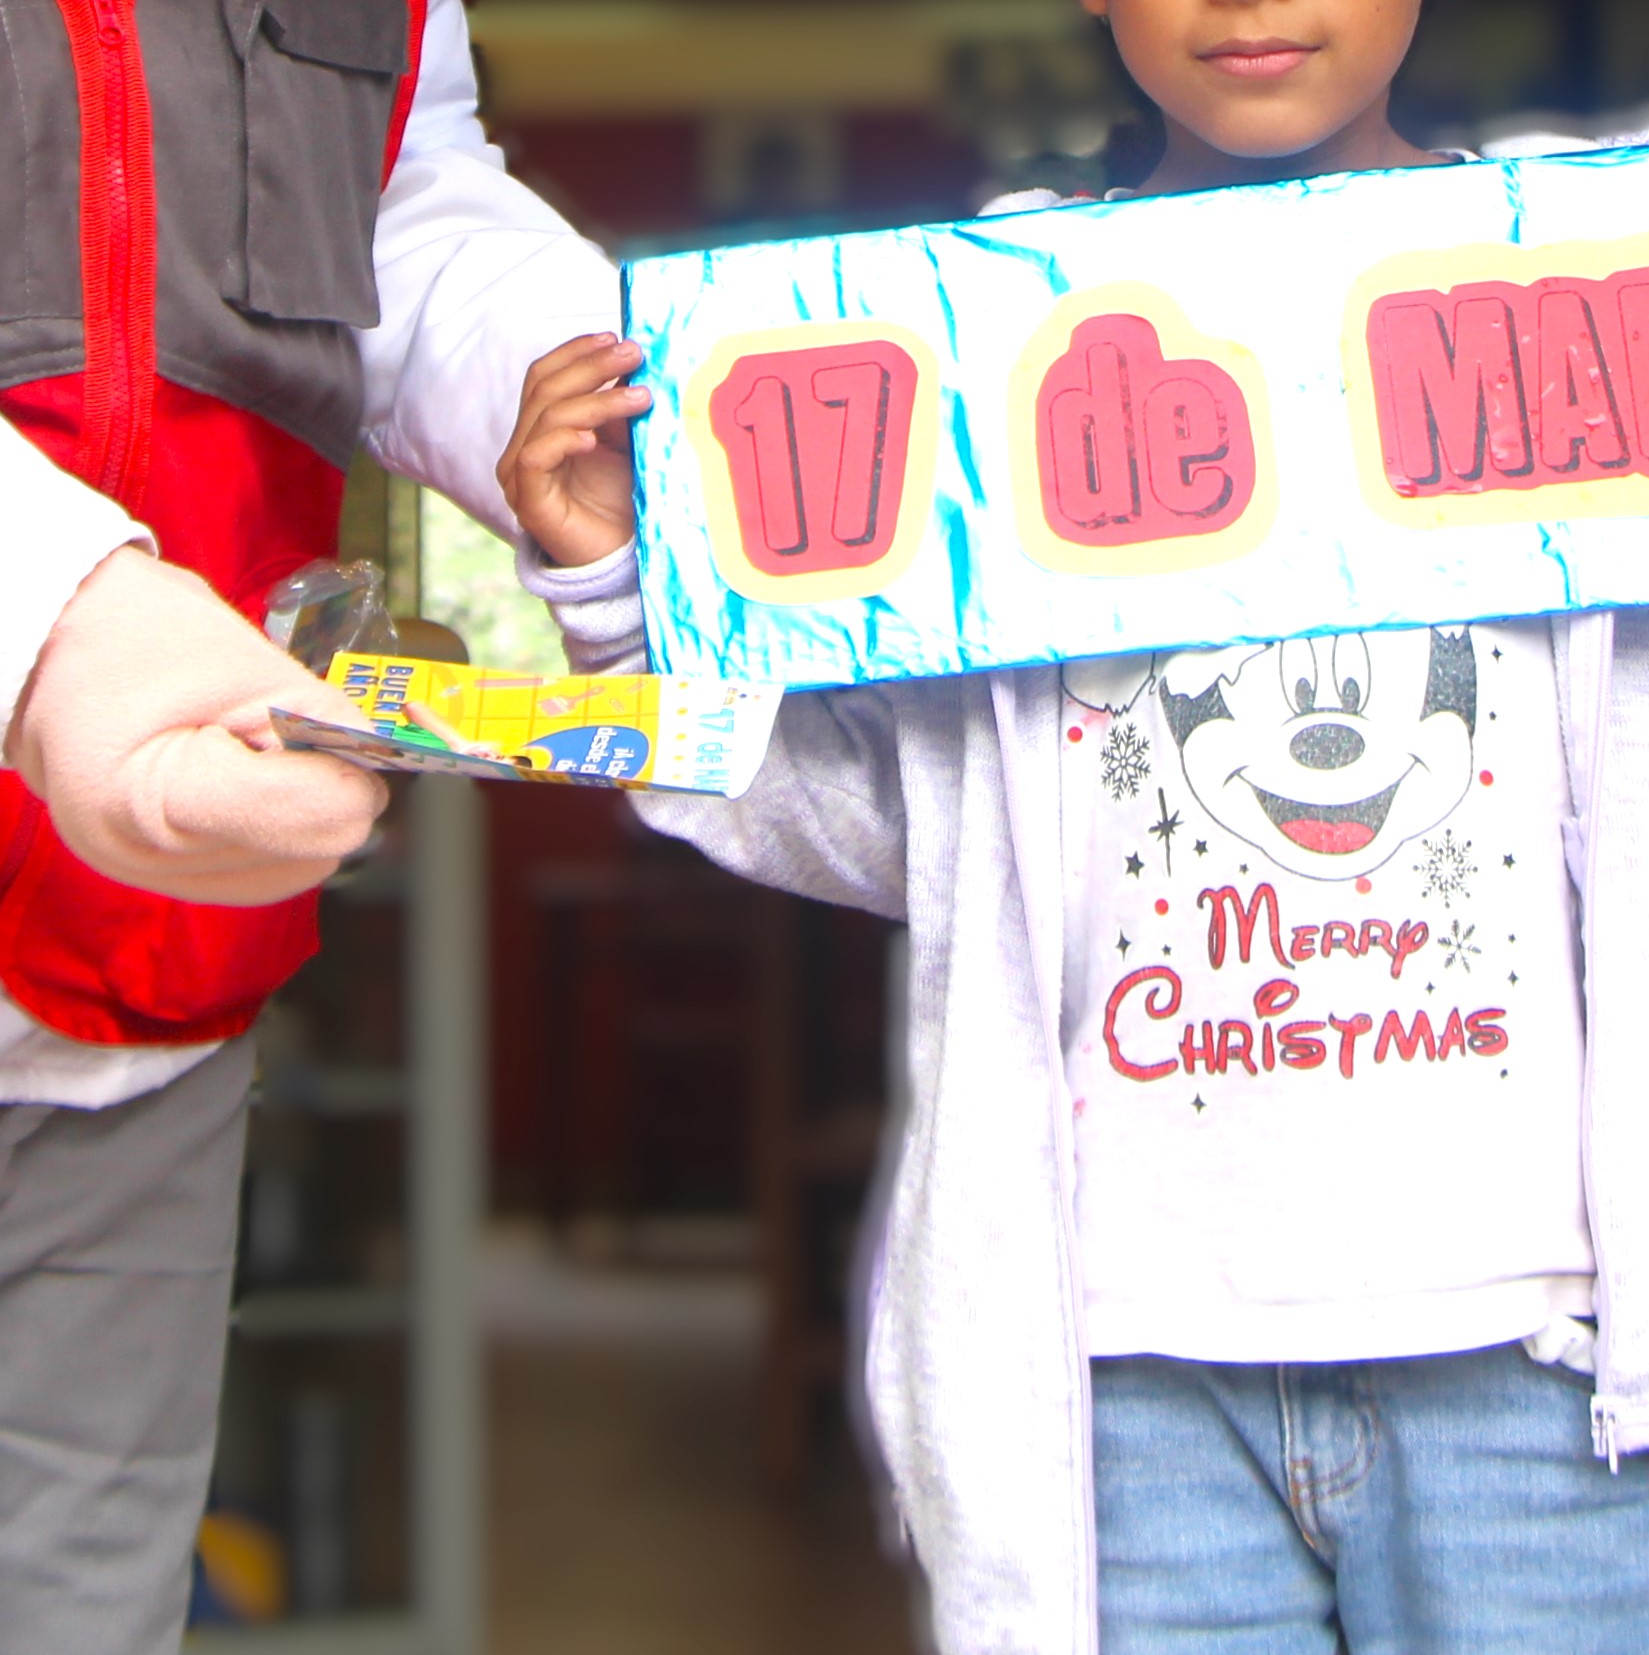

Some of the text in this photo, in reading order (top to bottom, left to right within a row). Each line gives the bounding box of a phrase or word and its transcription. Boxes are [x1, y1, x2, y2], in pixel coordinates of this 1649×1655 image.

[734, 361, 890, 556] 17
[1049, 342, 1233, 530] de
[343, 662, 379, 697] AÑO
[373, 665, 414, 712] BUEN
[698, 708, 734, 733] 17
[584, 726, 618, 763] desde
[695, 742, 732, 763] de
